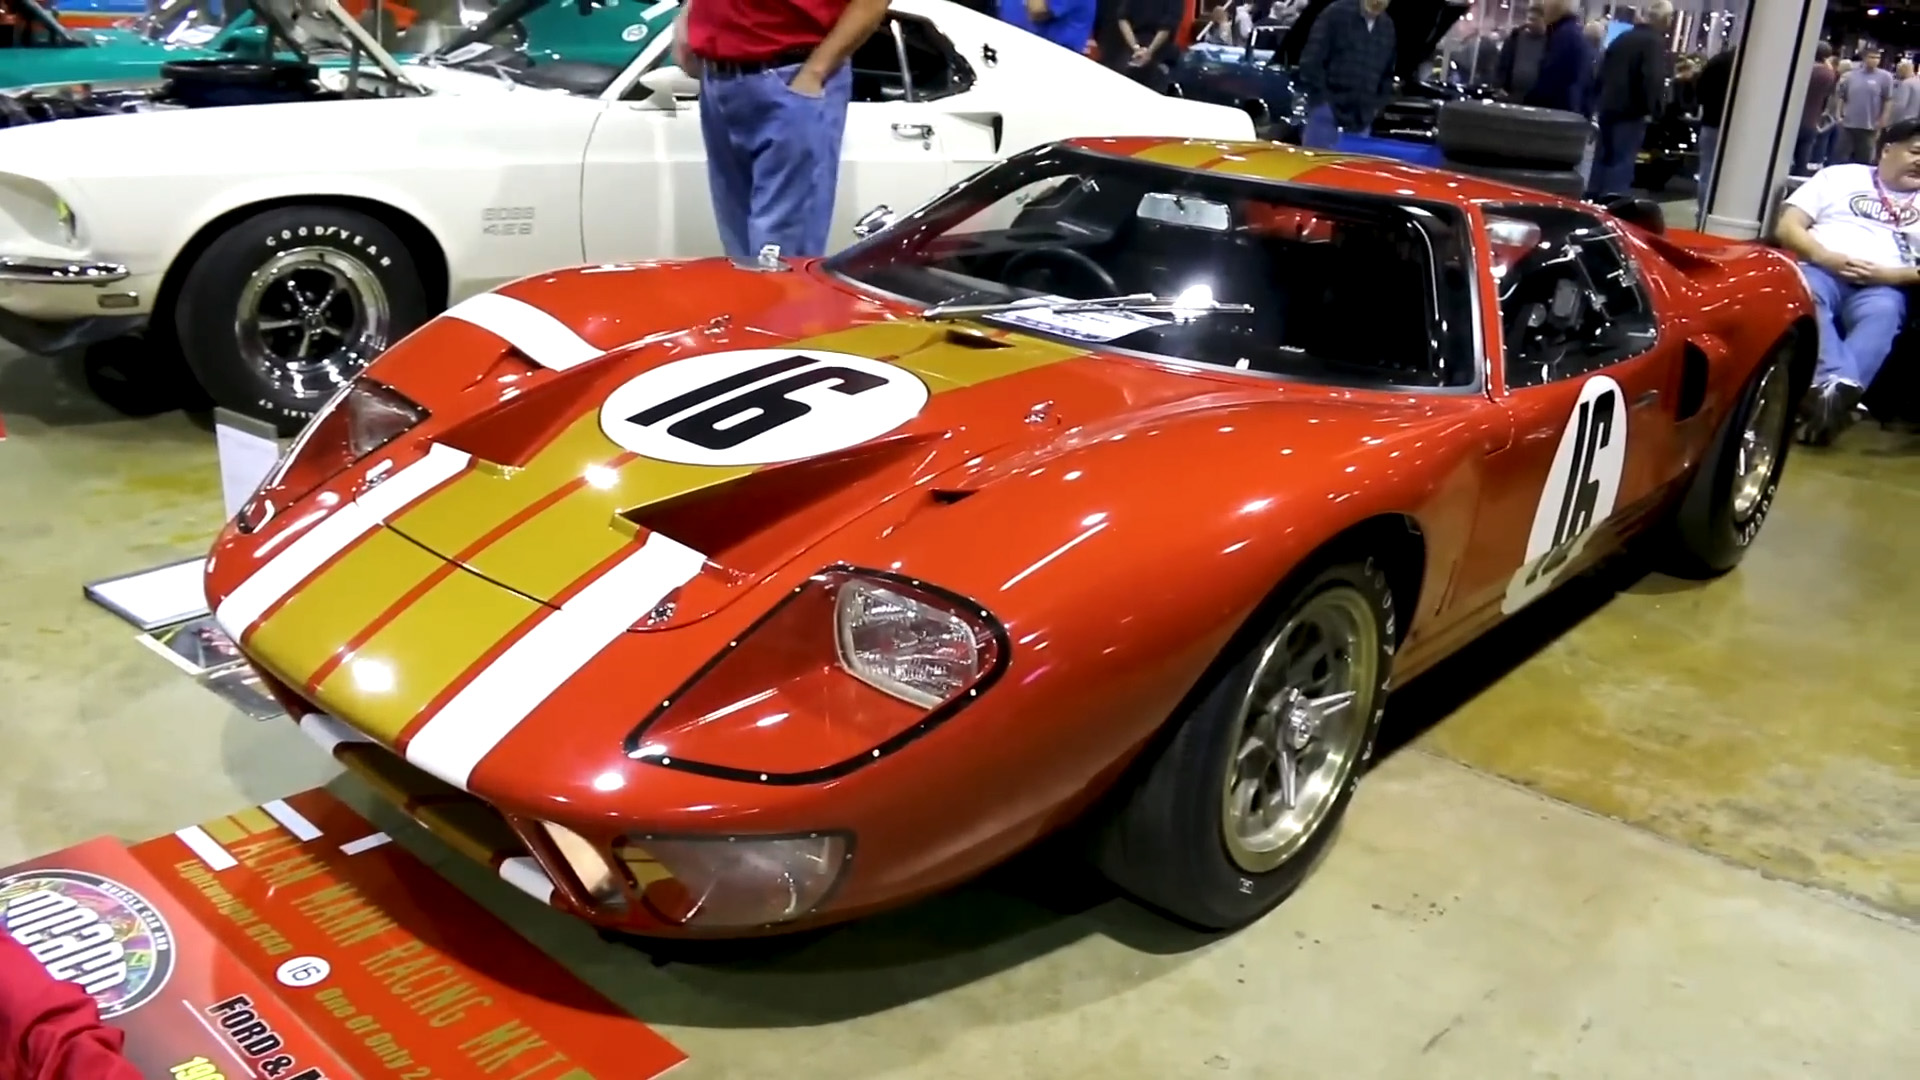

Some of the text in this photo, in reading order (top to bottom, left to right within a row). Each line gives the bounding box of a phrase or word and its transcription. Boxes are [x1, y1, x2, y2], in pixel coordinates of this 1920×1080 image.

[266, 226, 391, 267] GOODYEAR
[624, 355, 890, 450] 16
[1525, 389, 1615, 586] 16
[174, 858, 294, 956] Lightweight GT40
[231, 836, 331, 888] ALAN
[290, 881, 398, 947] MANN
[358, 940, 493, 1027] RACING
[287, 961, 321, 982] 16
[205, 994, 284, 1057] FORD
[315, 987, 356, 1018] One
[344, 1015, 381, 1034] Of
[364, 1032, 414, 1069] Only
